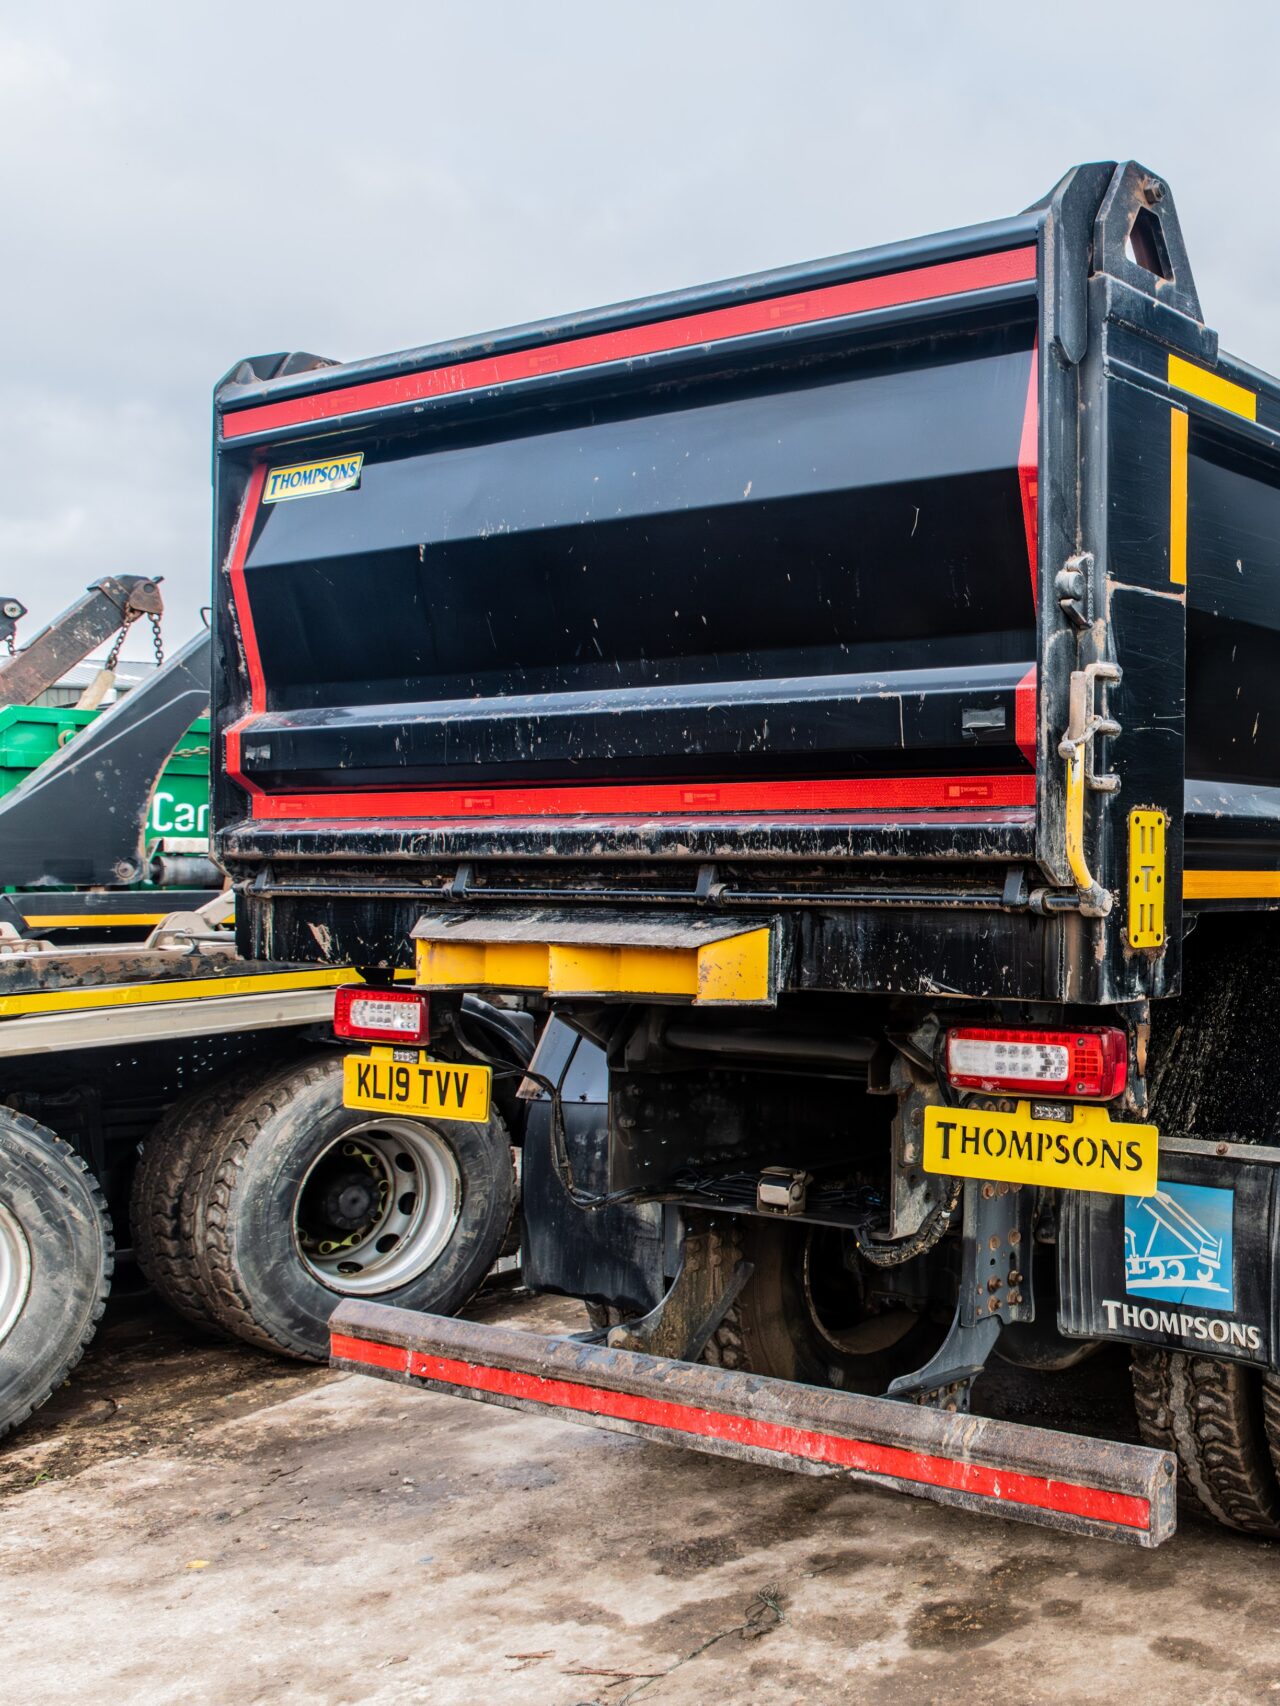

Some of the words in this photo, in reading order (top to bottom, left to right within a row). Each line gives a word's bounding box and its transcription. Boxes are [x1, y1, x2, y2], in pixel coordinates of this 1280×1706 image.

[270, 461, 358, 495] THOMPSONS
[145, 791, 209, 832] Car
[357, 1062, 410, 1102] KL19
[418, 1068, 469, 1108] TVV
[936, 1121, 1143, 1172] THOMPSONS
[1102, 1299, 1262, 1351] THOMPSONS
